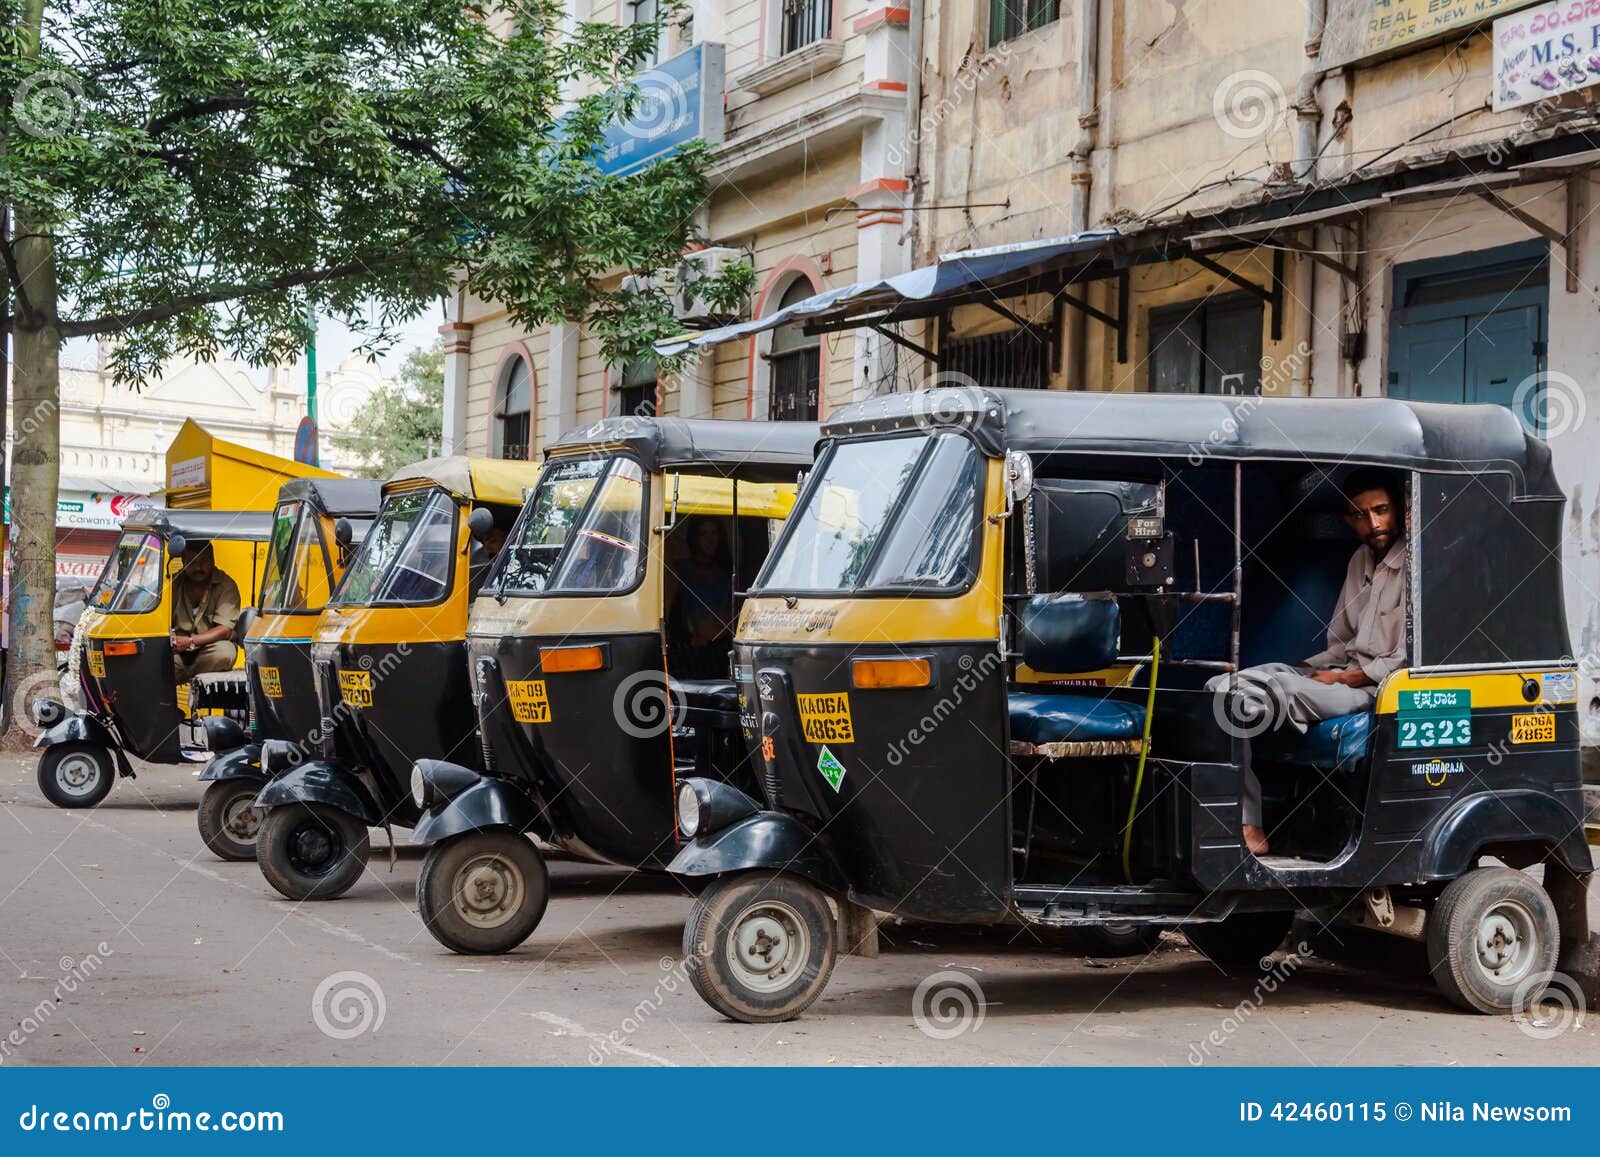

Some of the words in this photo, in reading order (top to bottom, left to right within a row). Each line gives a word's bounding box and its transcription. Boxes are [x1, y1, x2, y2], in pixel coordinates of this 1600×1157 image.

[1368, 8, 1417, 33] REAL
[1391, 24, 1416, 40] FOR
[1434, 8, 1467, 25] NEW
[1530, 32, 1582, 68] M.S.
[1134, 528, 1158, 536] Hire
[1136, 519, 1155, 528] For
[799, 697, 847, 715] KA06A
[805, 718, 852, 740] 4863
[1514, 716, 1552, 727] KA06A
[1401, 719, 1472, 747] 2323
[1514, 727, 1553, 742] 4863
[1412, 761, 1464, 775] KRISHNARAJA
